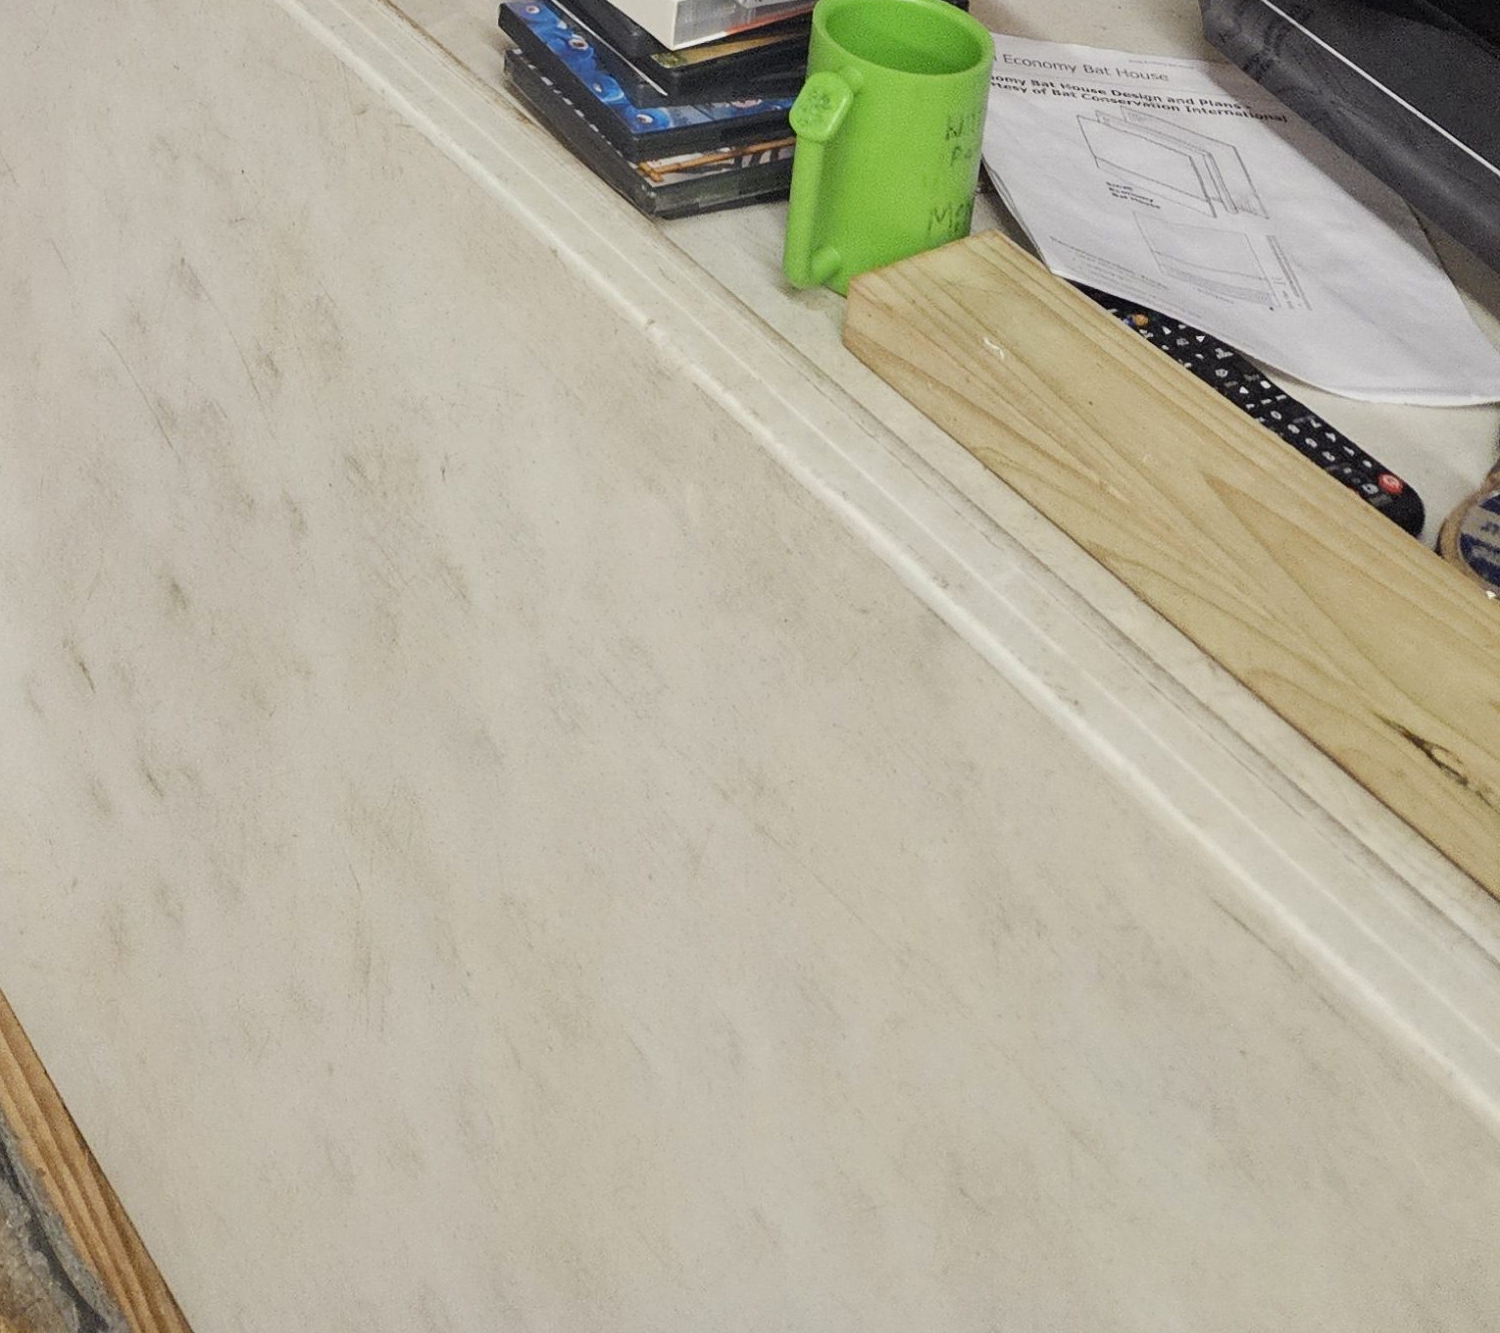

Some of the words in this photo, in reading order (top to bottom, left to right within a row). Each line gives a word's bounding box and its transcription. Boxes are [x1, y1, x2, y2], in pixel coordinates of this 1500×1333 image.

[1003, 53, 1077, 74] Economy
[1082, 63, 1113, 76] Bat
[1116, 67, 1170, 82] House
[1030, 79, 1058, 89] Bat
[1060, 82, 1107, 95] House
[1110, 88, 1160, 102] Design
[1167, 94, 1195, 105] and
[1032, 86, 1048, 95] of
[1052, 88, 1078, 99] Bat
[1185, 105, 1288, 123] International
